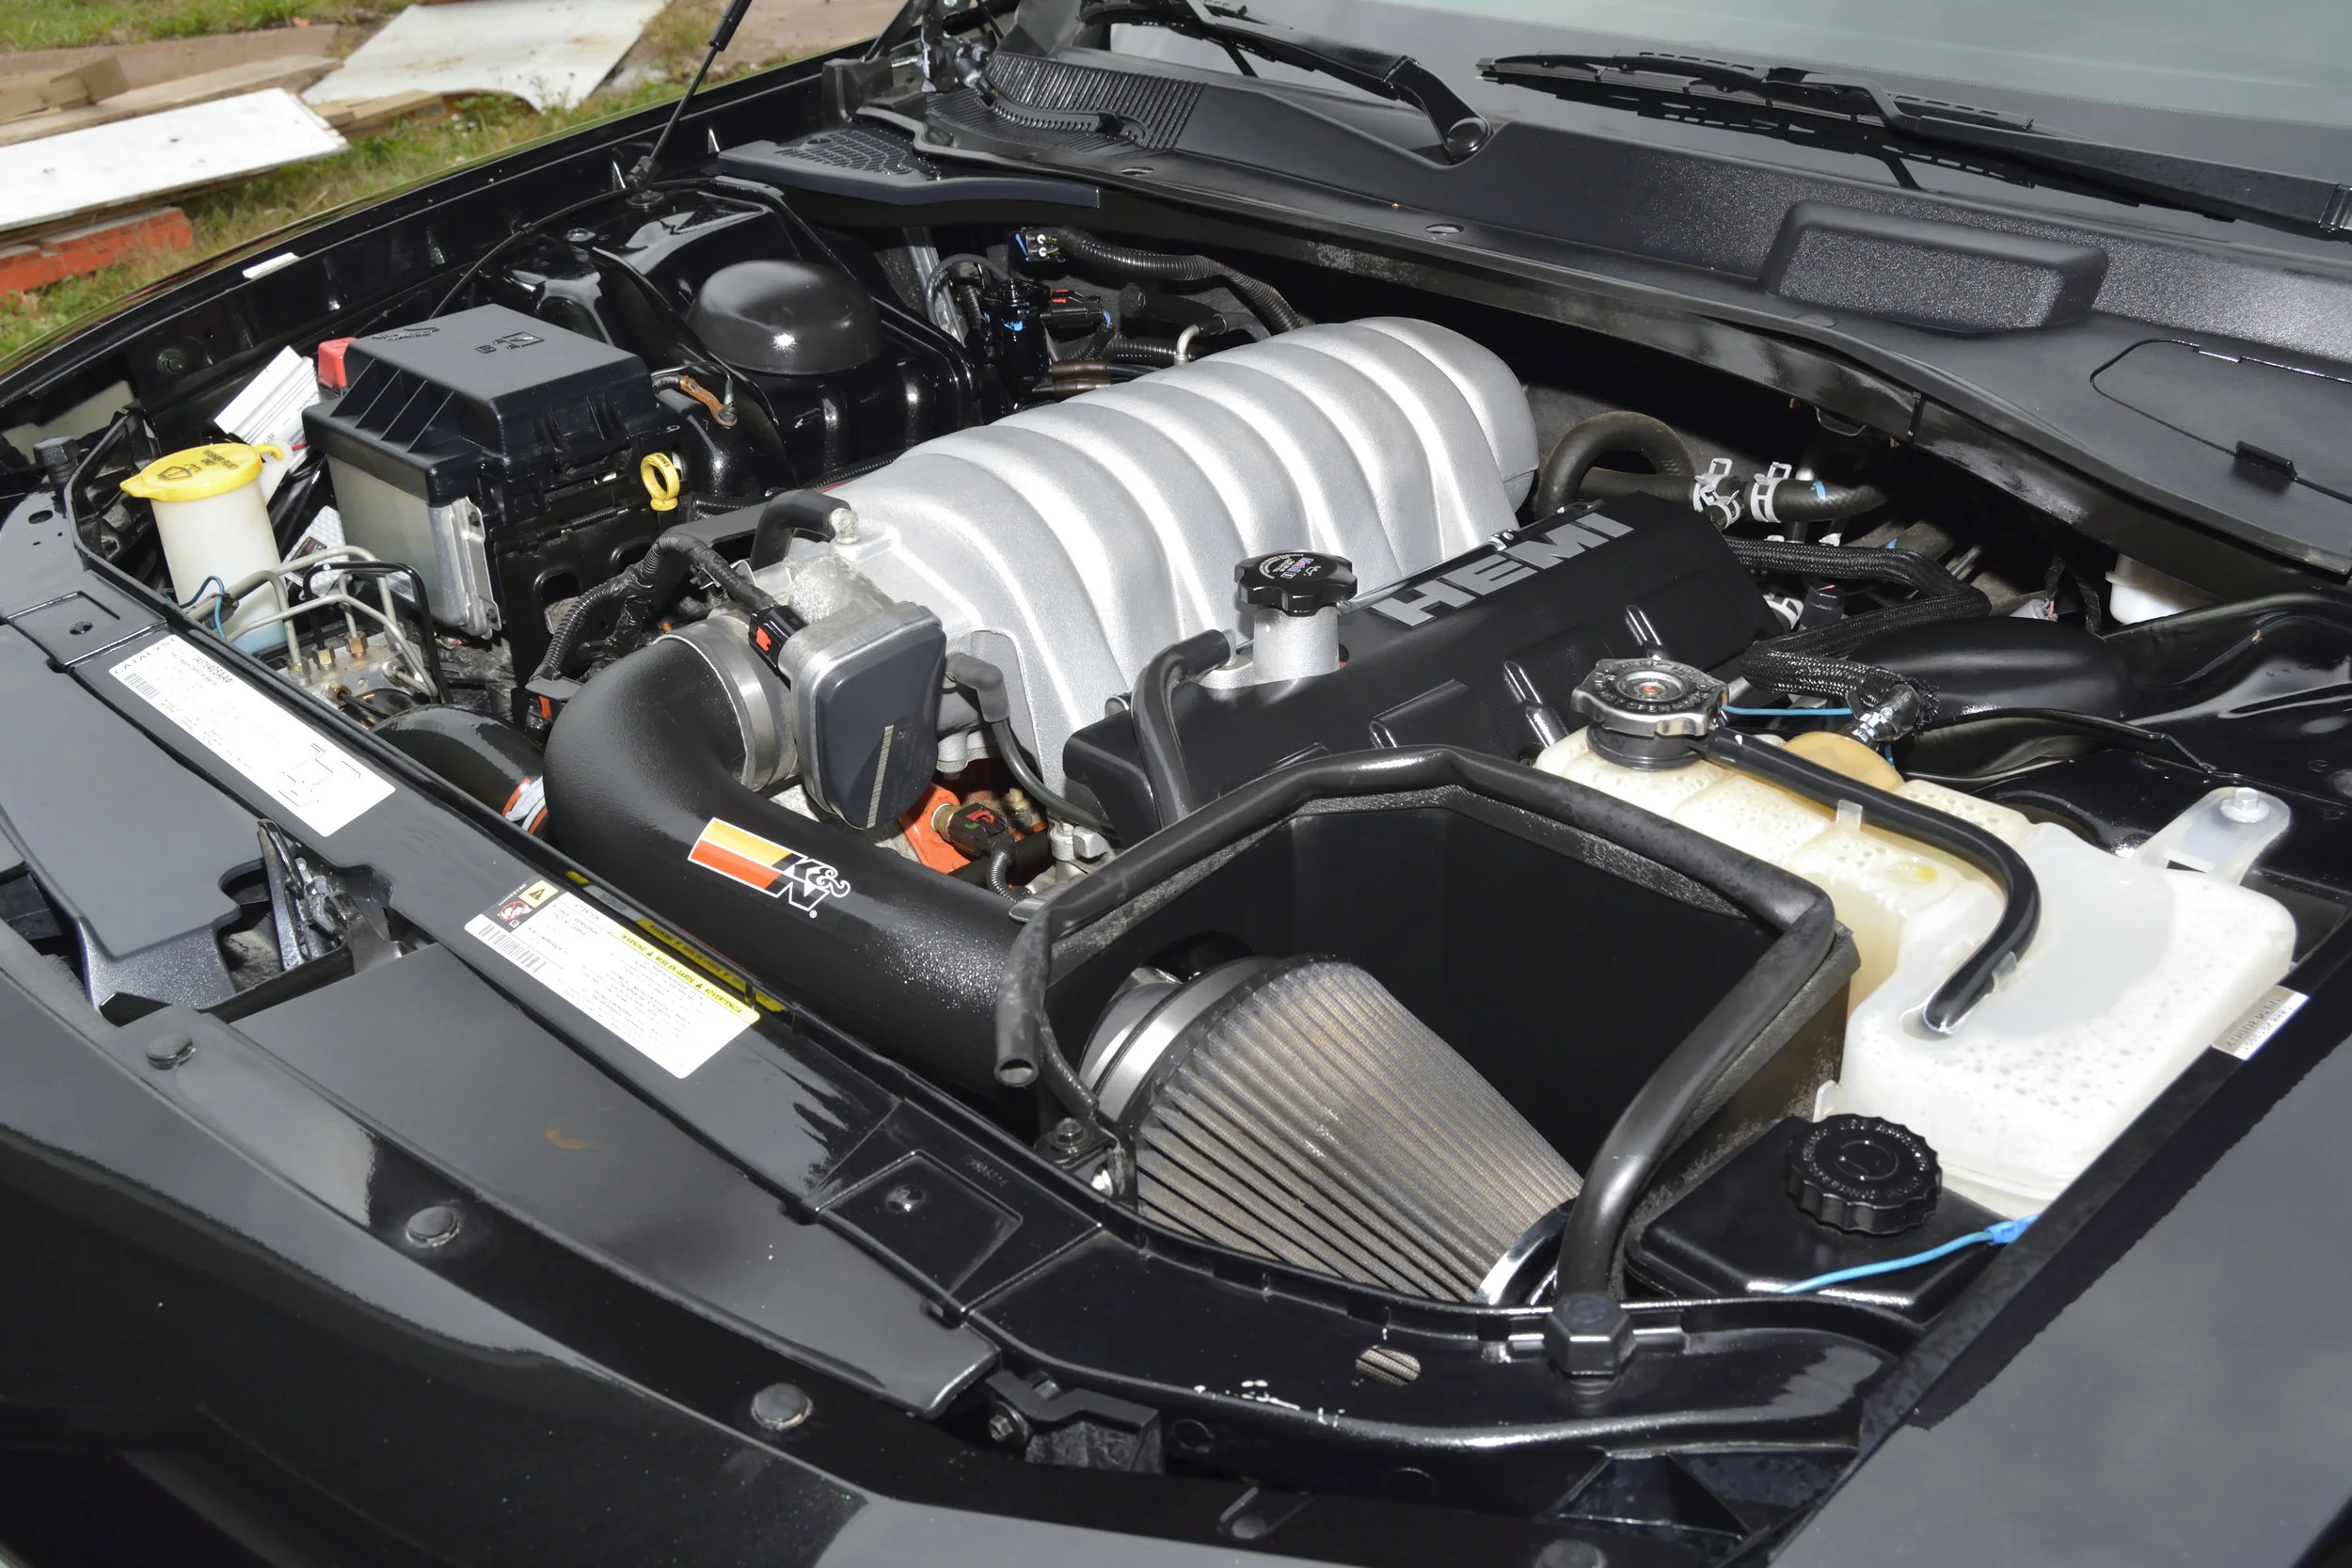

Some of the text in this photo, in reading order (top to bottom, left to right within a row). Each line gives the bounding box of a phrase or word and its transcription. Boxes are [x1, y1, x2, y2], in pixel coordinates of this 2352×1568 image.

[1369, 512, 1635, 627] HEMI
[114, 638, 176, 674] CATALYST
[621, 934, 647, 952] WARNING
[655, 956, 670, 967] MISE
[676, 970, 696, 984] GARDE
[705, 988, 742, 1014] ADVERTENCIA
